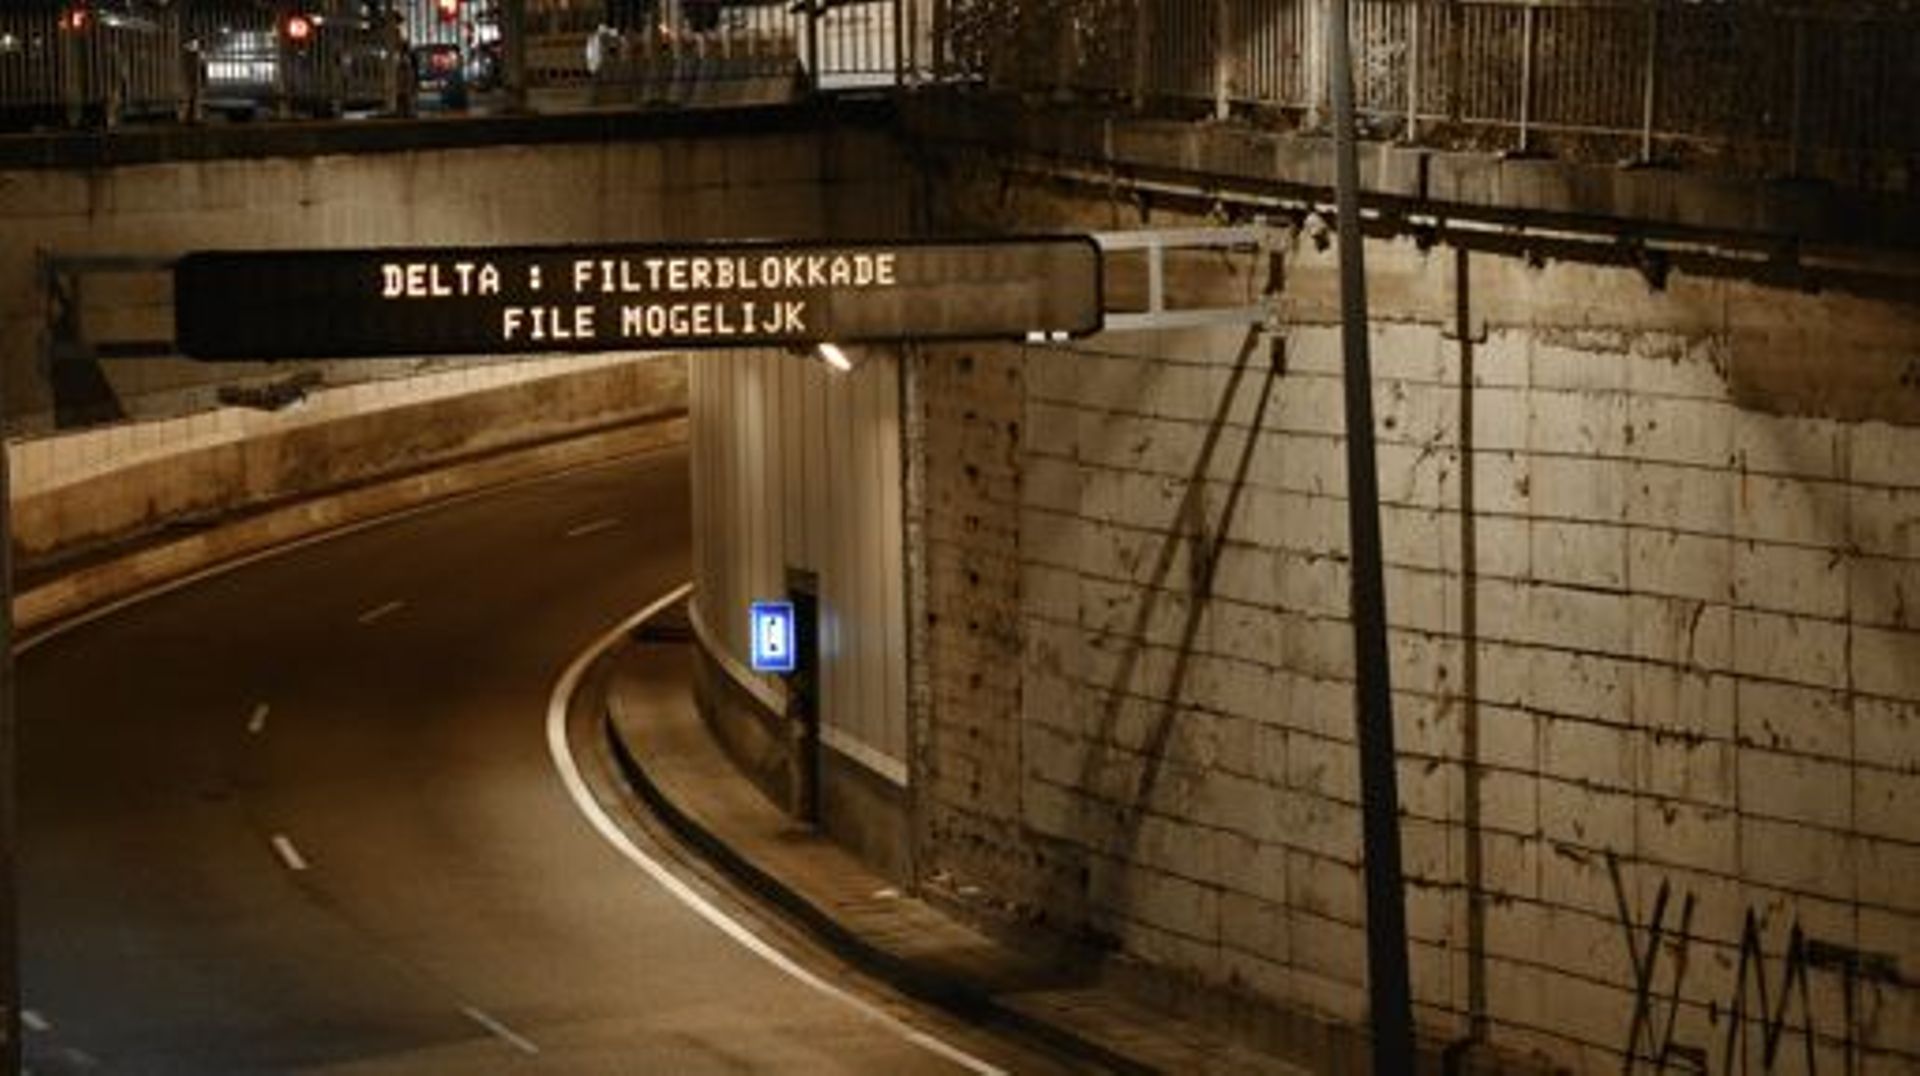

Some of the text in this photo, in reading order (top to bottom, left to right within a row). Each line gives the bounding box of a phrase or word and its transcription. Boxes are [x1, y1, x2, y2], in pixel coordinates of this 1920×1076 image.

[382, 253, 897, 297] DELTA : FILTERBLOKKADE
[502, 301, 805, 339] FILE MOGELIJK
